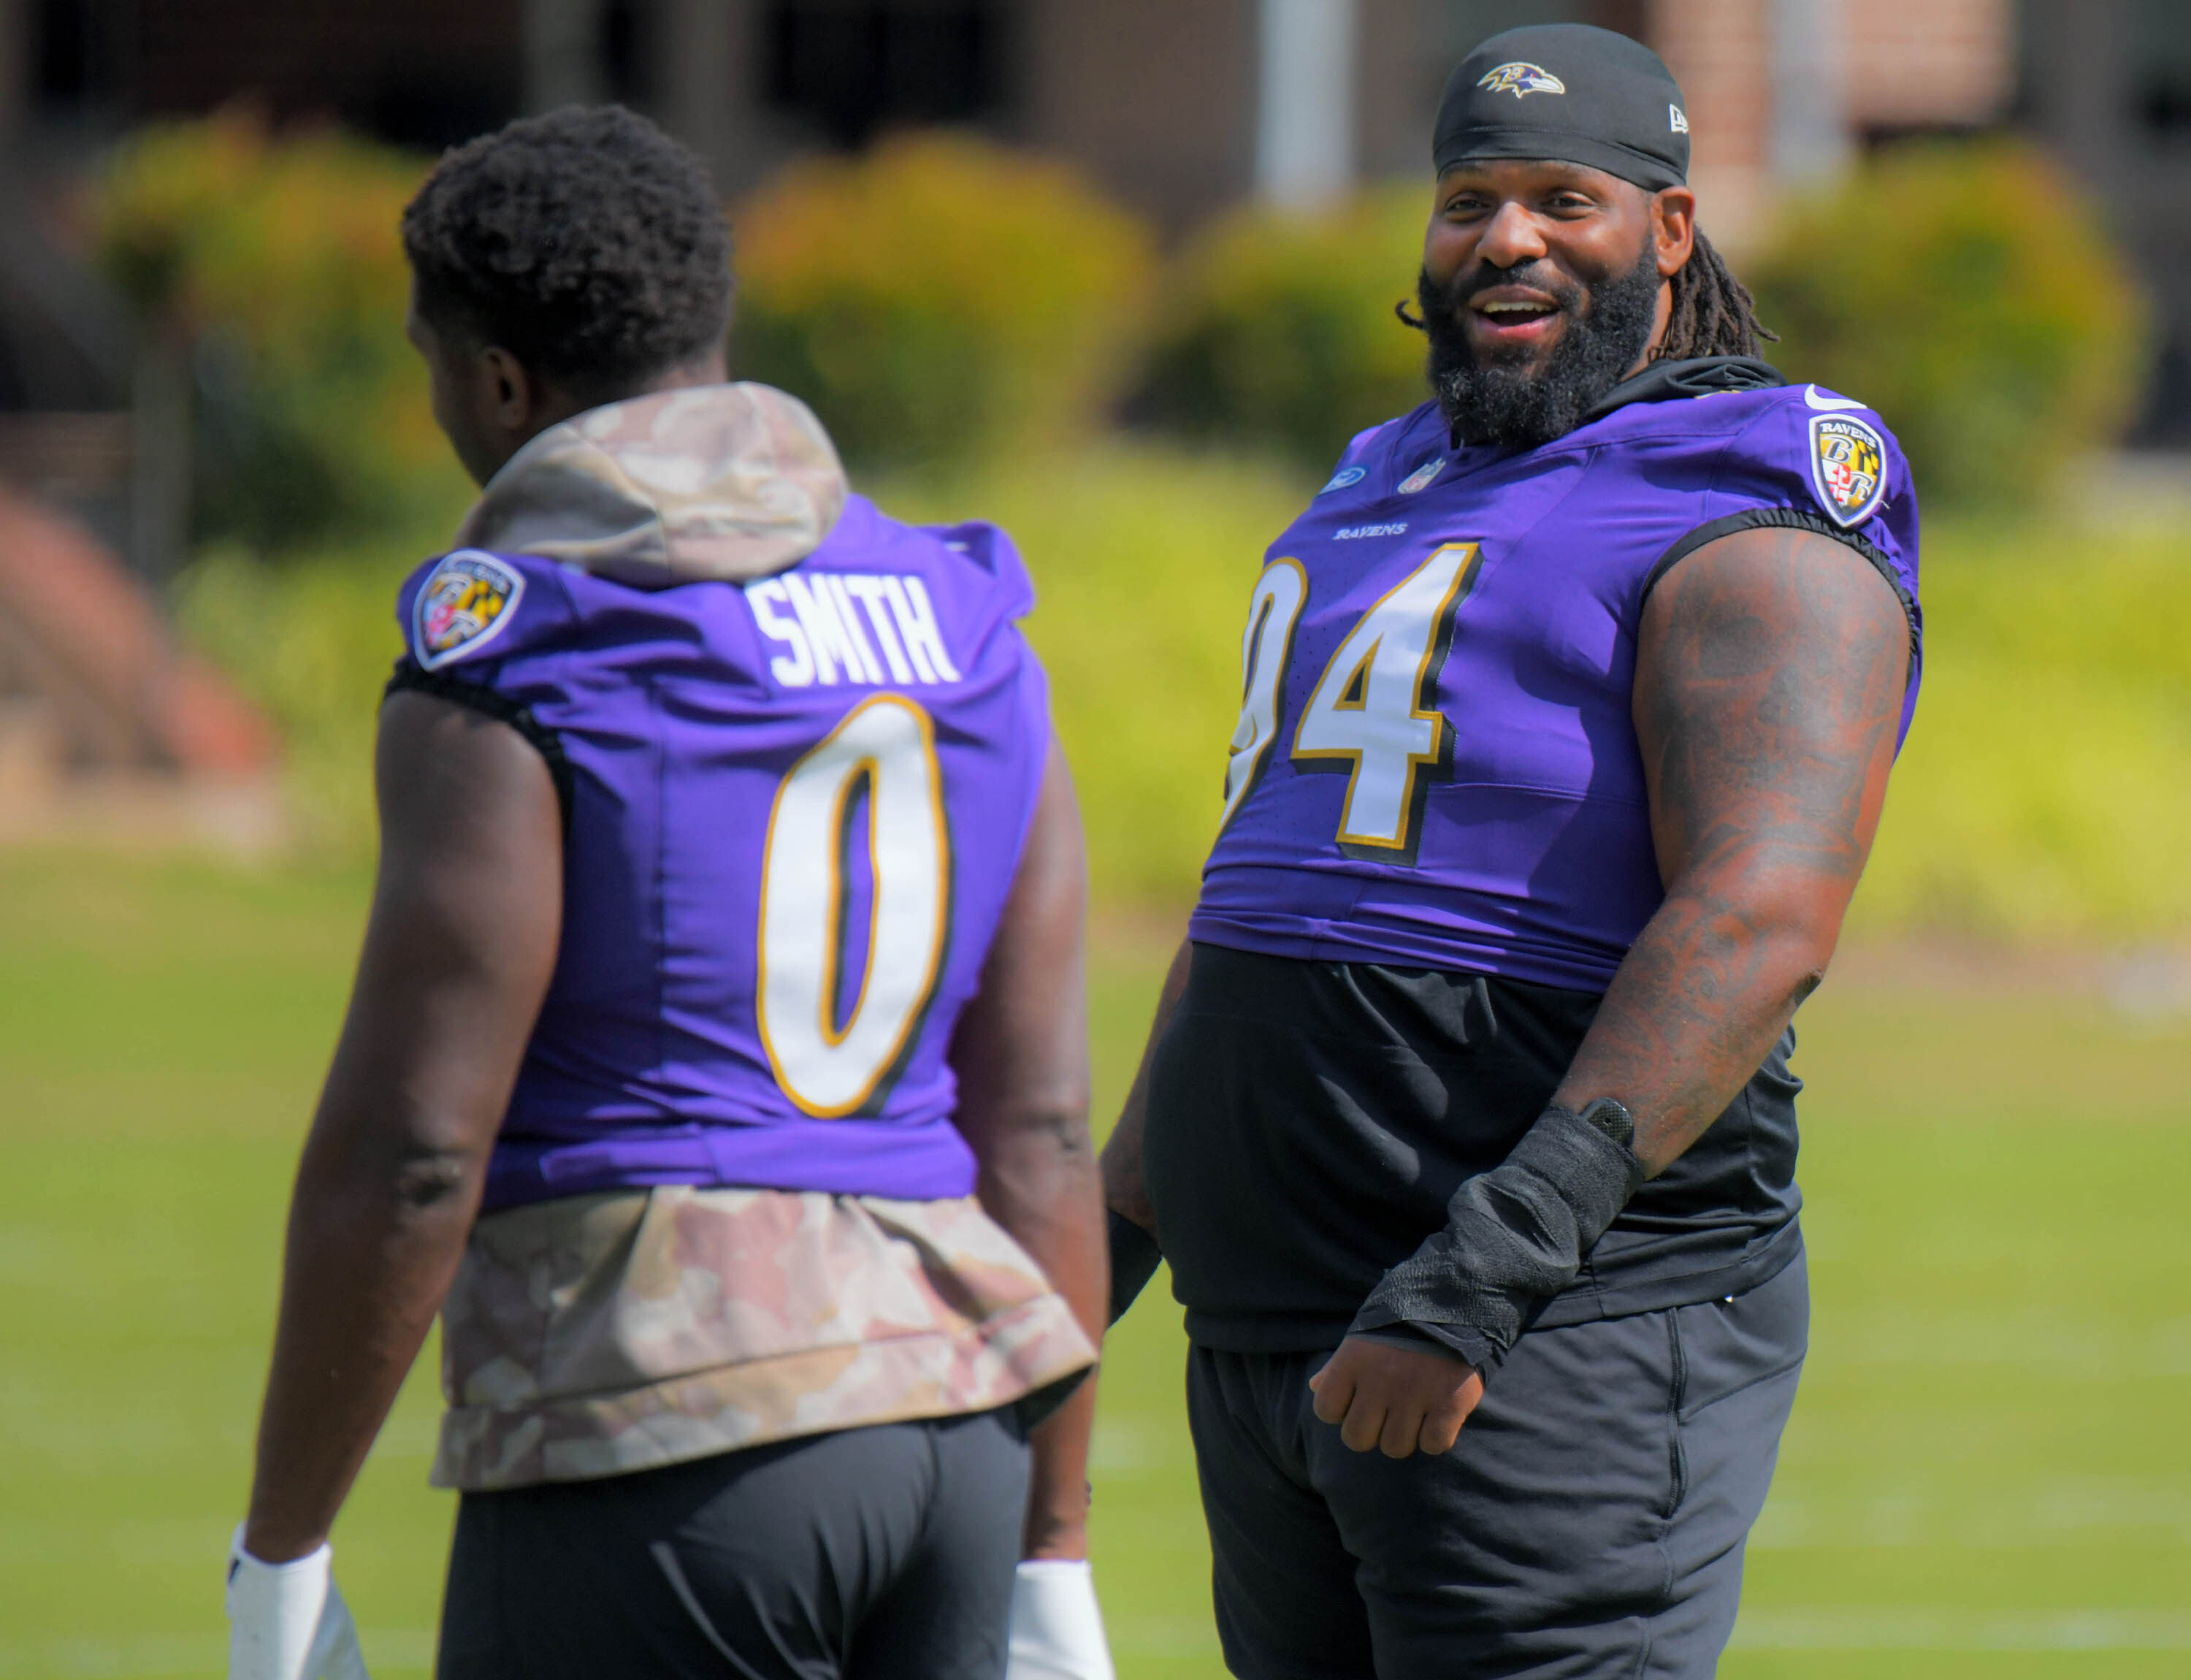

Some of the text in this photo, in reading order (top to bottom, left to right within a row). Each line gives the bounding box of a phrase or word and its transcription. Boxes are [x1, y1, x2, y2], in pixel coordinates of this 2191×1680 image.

[1821, 423, 1876, 448] RAVENS
[1333, 522, 1408, 540] RAVENS
[745, 573, 960, 687] SMITH
[1218, 542, 1485, 868] 94
[755, 692, 952, 1118] 0
